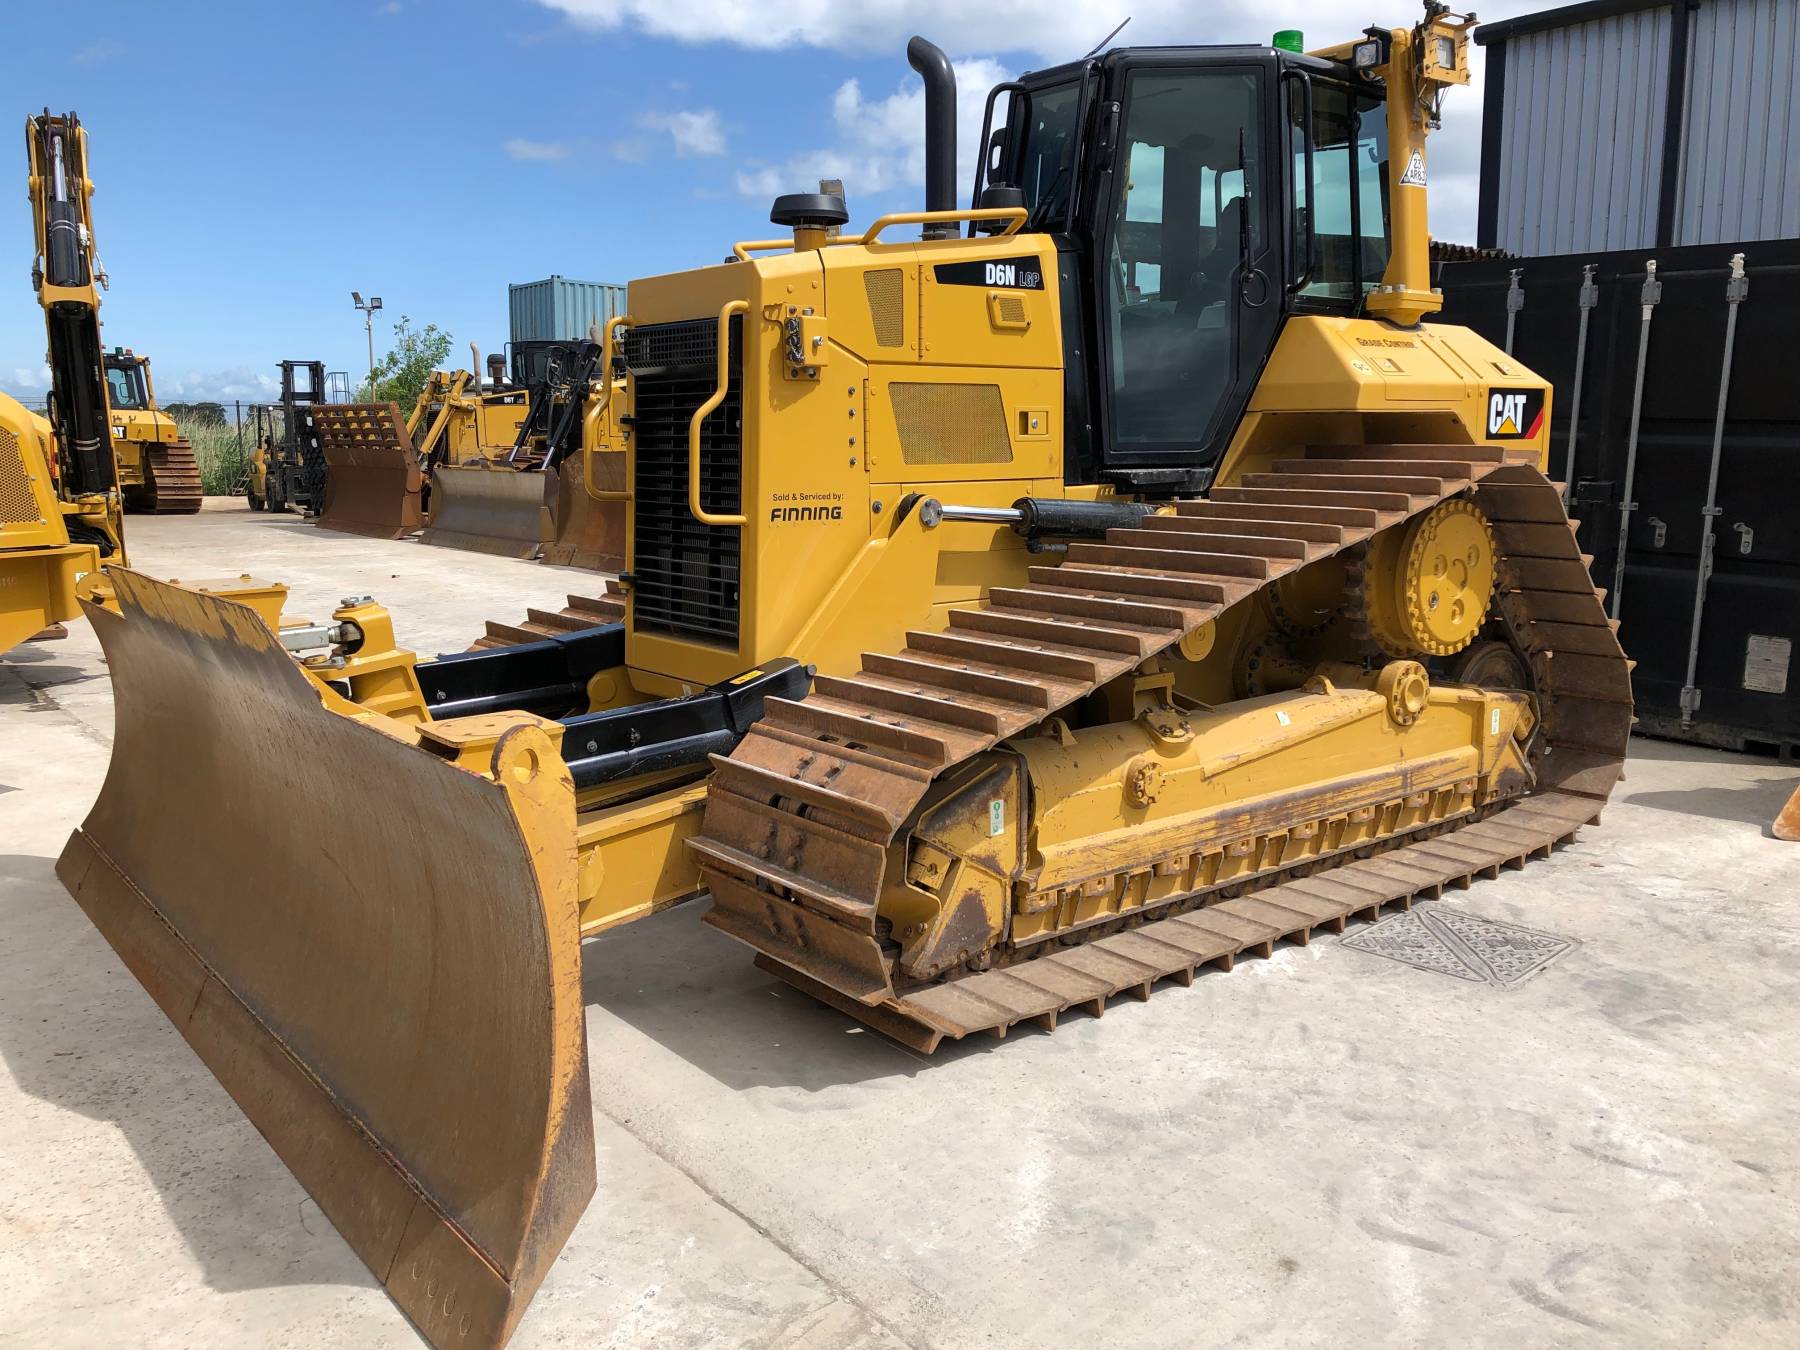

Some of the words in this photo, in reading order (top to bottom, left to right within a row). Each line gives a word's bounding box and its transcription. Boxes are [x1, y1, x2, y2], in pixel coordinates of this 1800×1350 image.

[985, 263, 1016, 286] D6N
[1019, 271, 1040, 288] LGP
[1489, 393, 1527, 434] CAT
[112, 426, 124, 438] AT
[772, 493, 790, 502] Sold
[791, 493, 798, 501] &
[799, 492, 831, 501] Serviced
[832, 492, 844, 502] by:
[770, 506, 842, 522] FINNING
